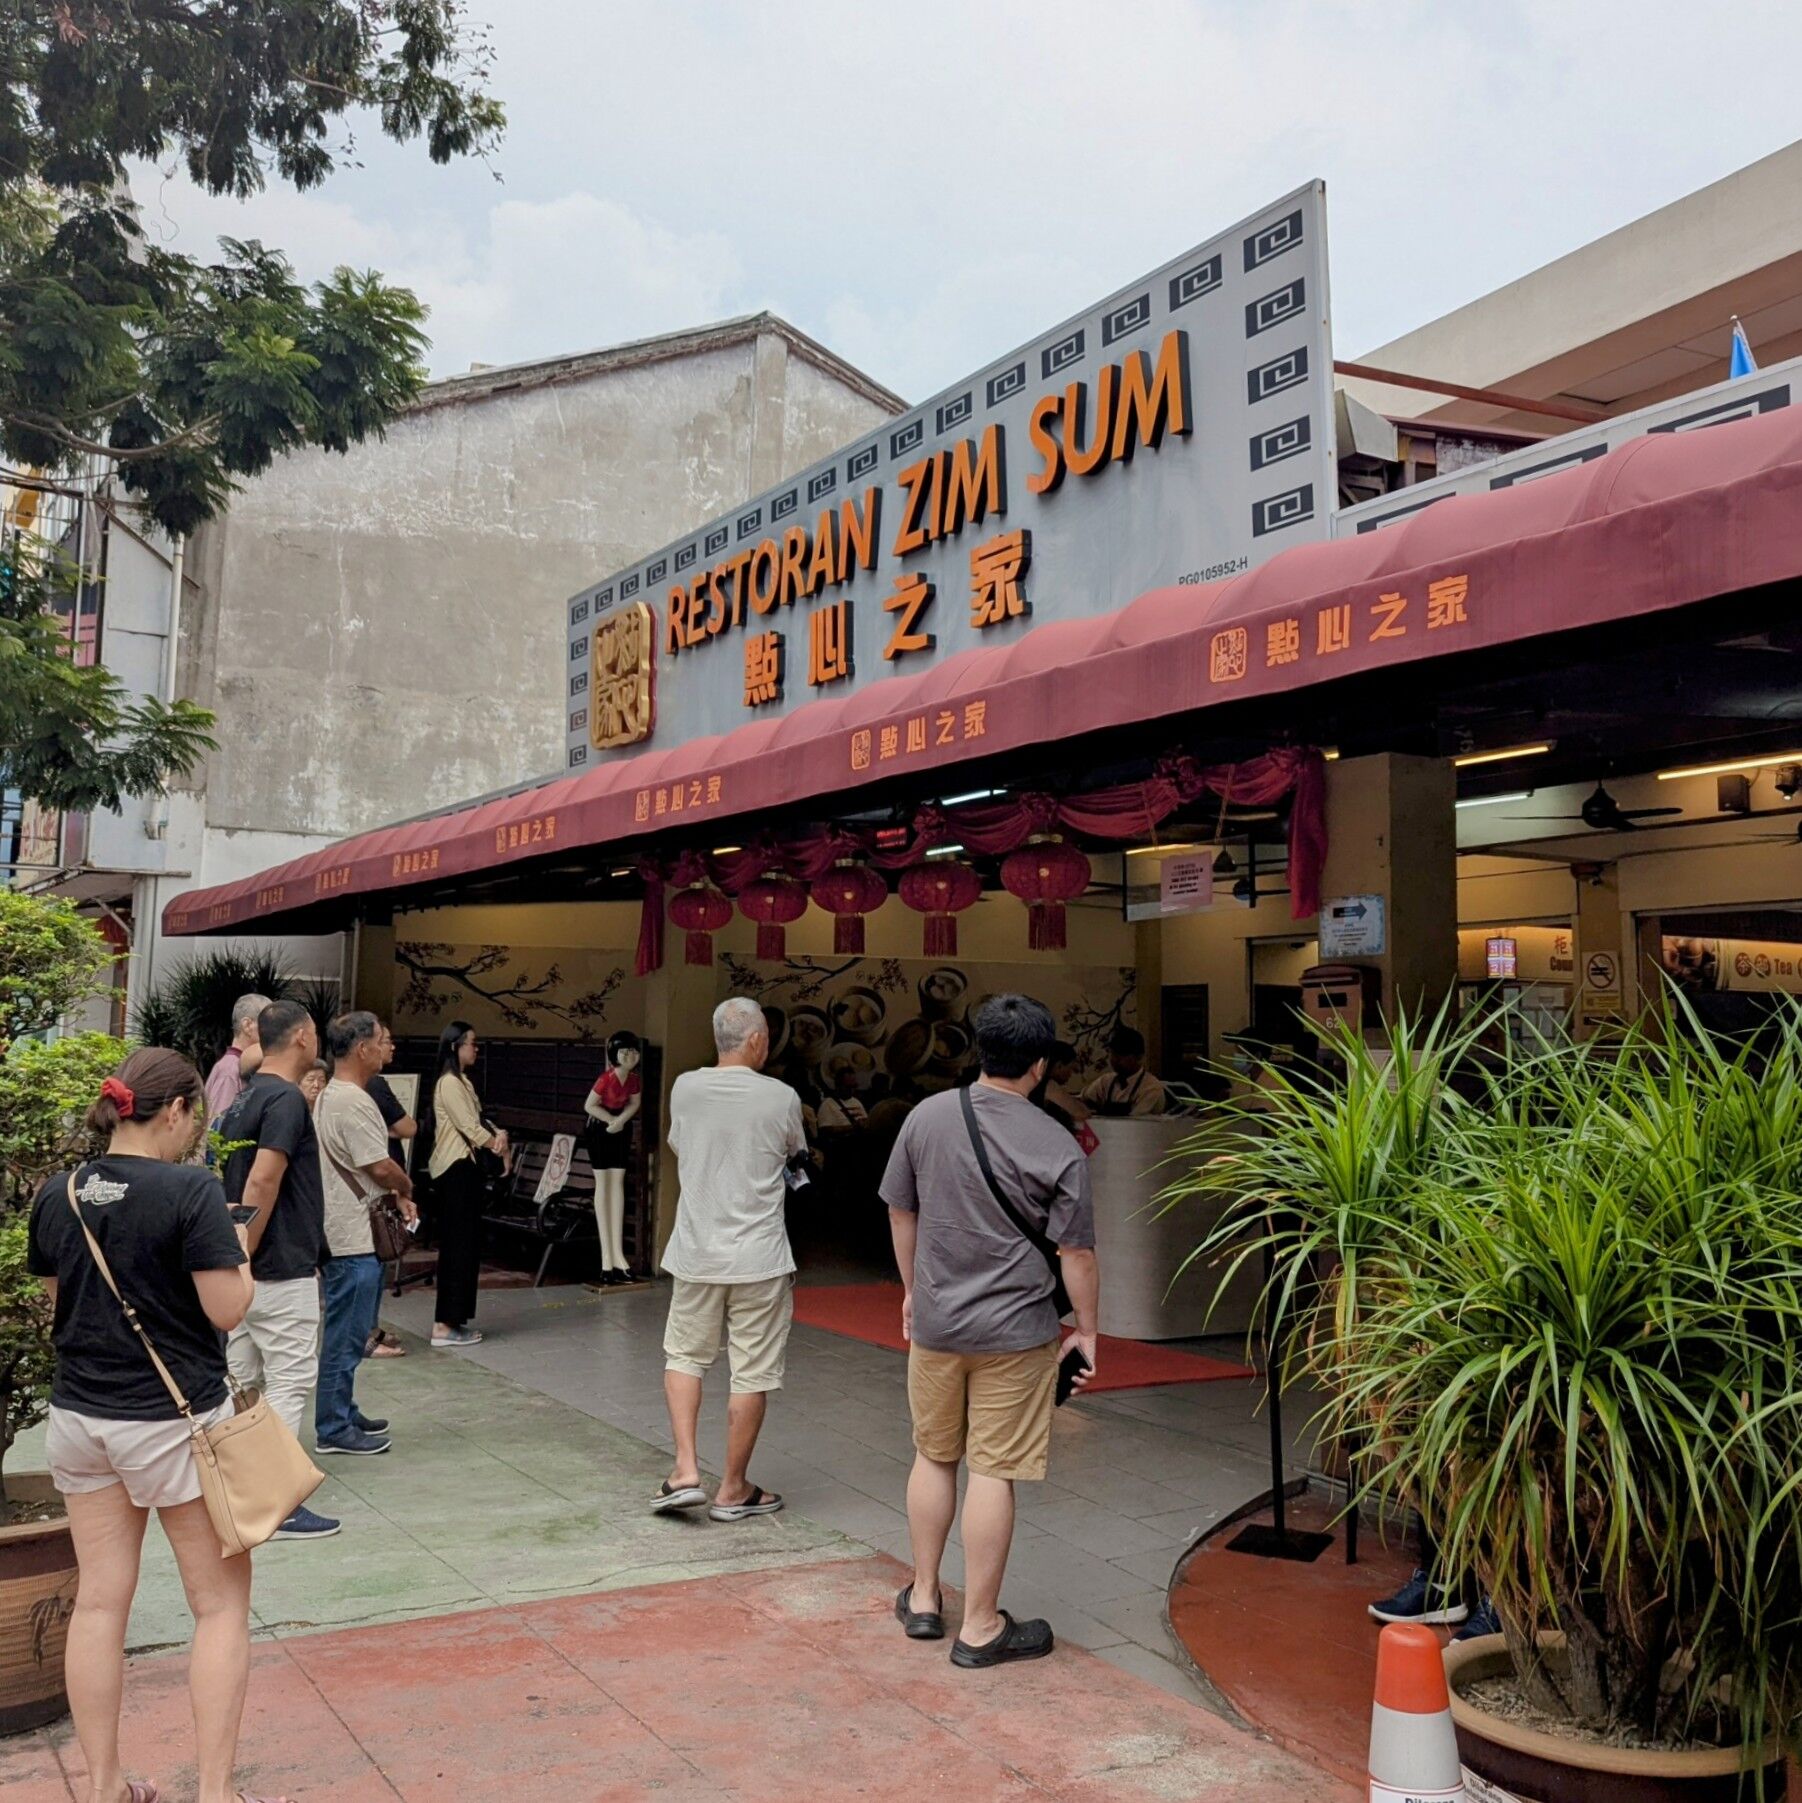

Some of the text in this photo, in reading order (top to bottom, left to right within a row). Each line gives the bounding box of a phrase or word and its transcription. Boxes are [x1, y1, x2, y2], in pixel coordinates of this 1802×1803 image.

[667, 329, 1193, 654] RESTORAN ZIM SUM
[1178, 556, 1248, 585] PG0105952-H
[742, 529, 1032, 706] 點心之家
[1266, 575, 1469, 667] 點心之家
[880, 700, 986, 760] 點心之家
[1774, 958, 1793, 975] Tea
